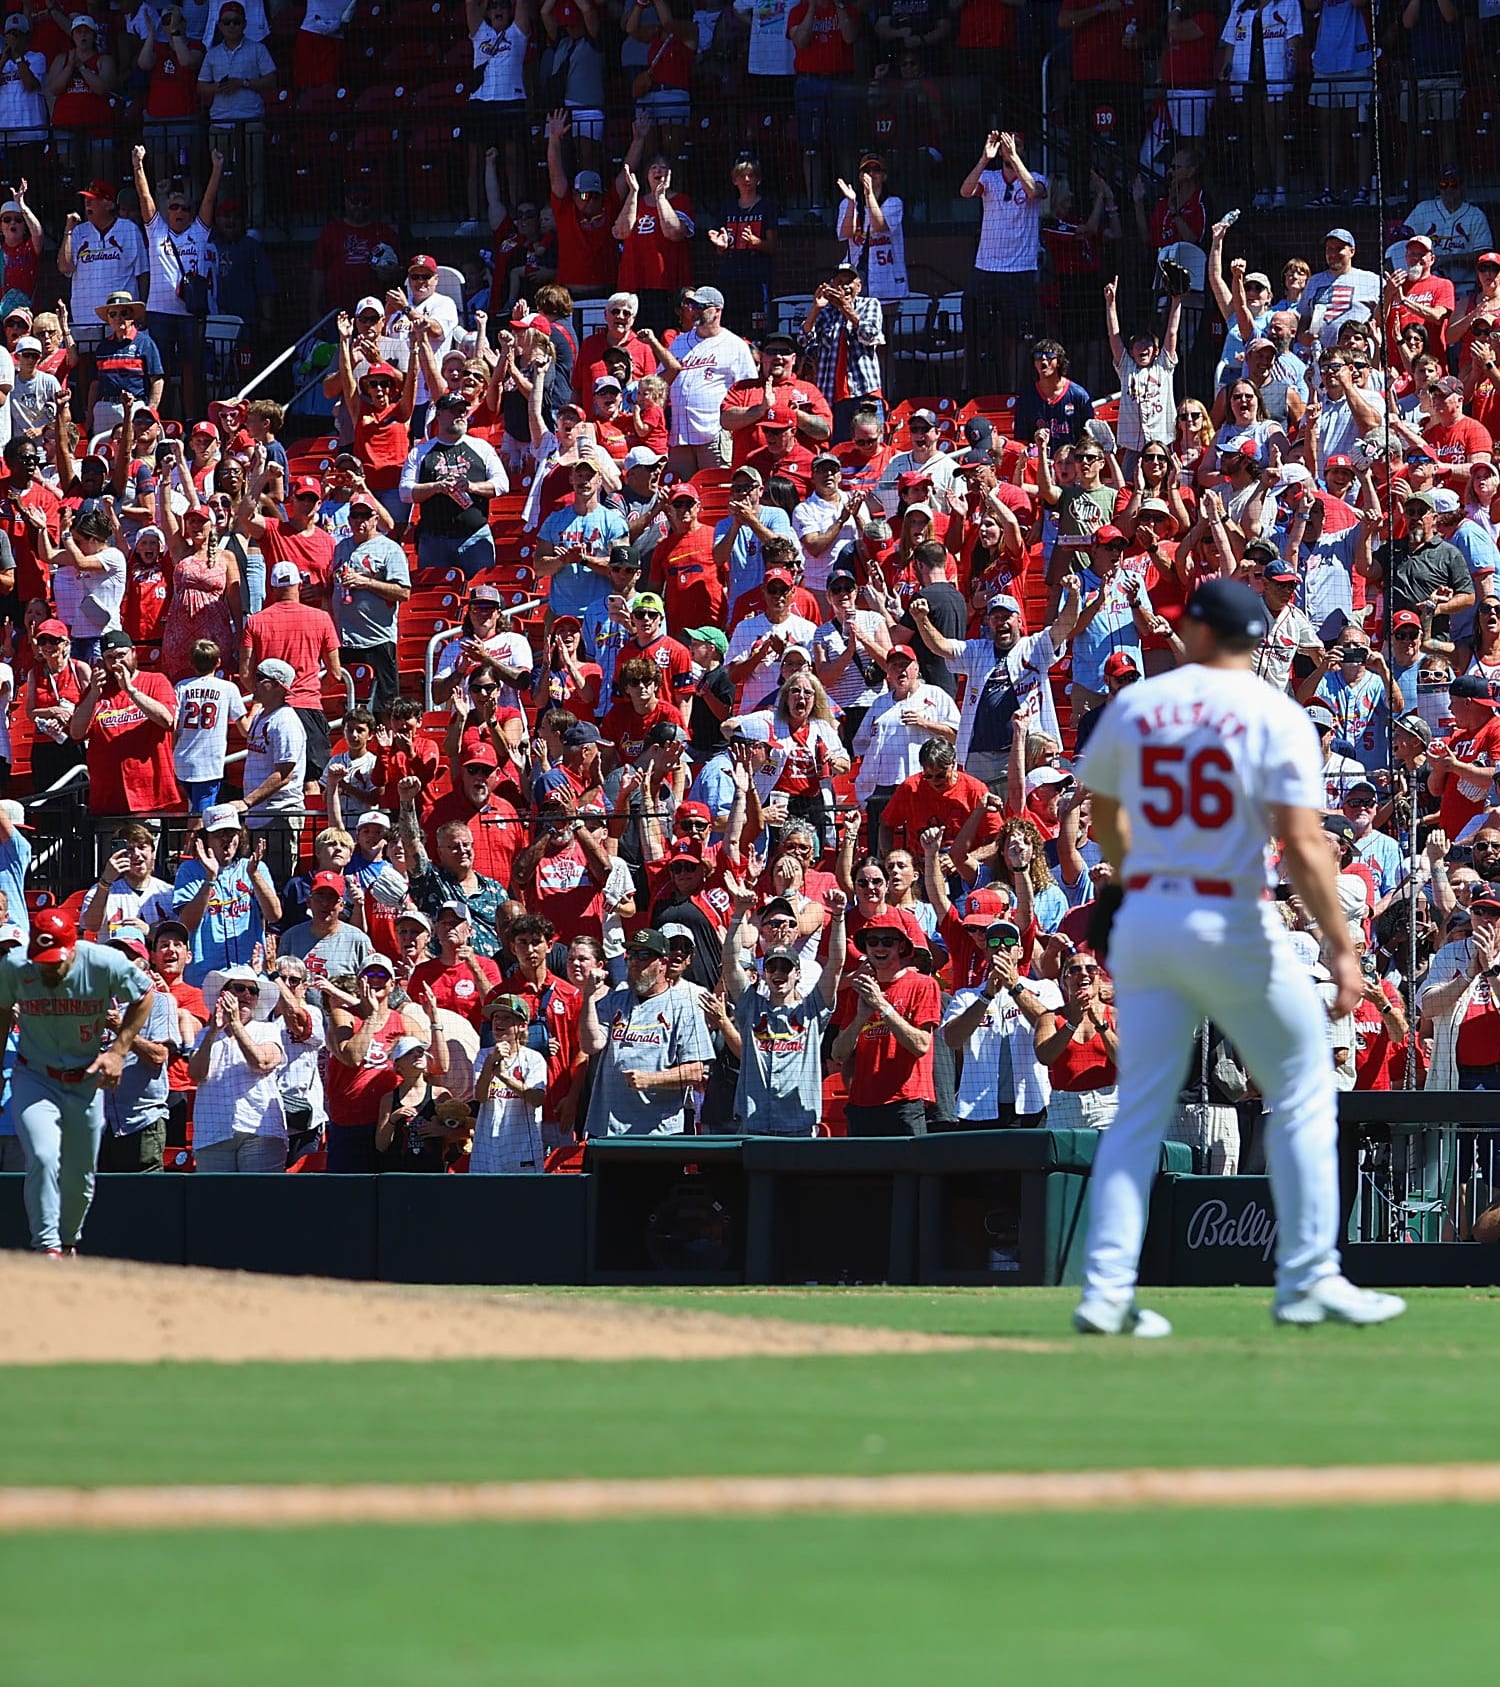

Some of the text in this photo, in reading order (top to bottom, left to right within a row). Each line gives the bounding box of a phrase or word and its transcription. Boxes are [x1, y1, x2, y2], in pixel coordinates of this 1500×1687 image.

[877, 120, 892, 132] 137
[1096, 112, 1112, 125] 139
[1442, 236, 1466, 251] Louis
[81, 250, 121, 264] Cardinals
[876, 250, 894, 266] 54
[240, 353, 251, 366] 137
[155, 587, 166, 600] 19
[185, 688, 221, 702] ARENADO
[184, 702, 217, 730] 28
[1363, 731, 1376, 751] 5
[1141, 745, 1235, 830] 56
[36, 933, 54, 948] C
[17, 998, 105, 1017] CINCINNATI
[612, 1027, 661, 1045] Cardinals
[1187, 1199, 1278, 1262] Bally
